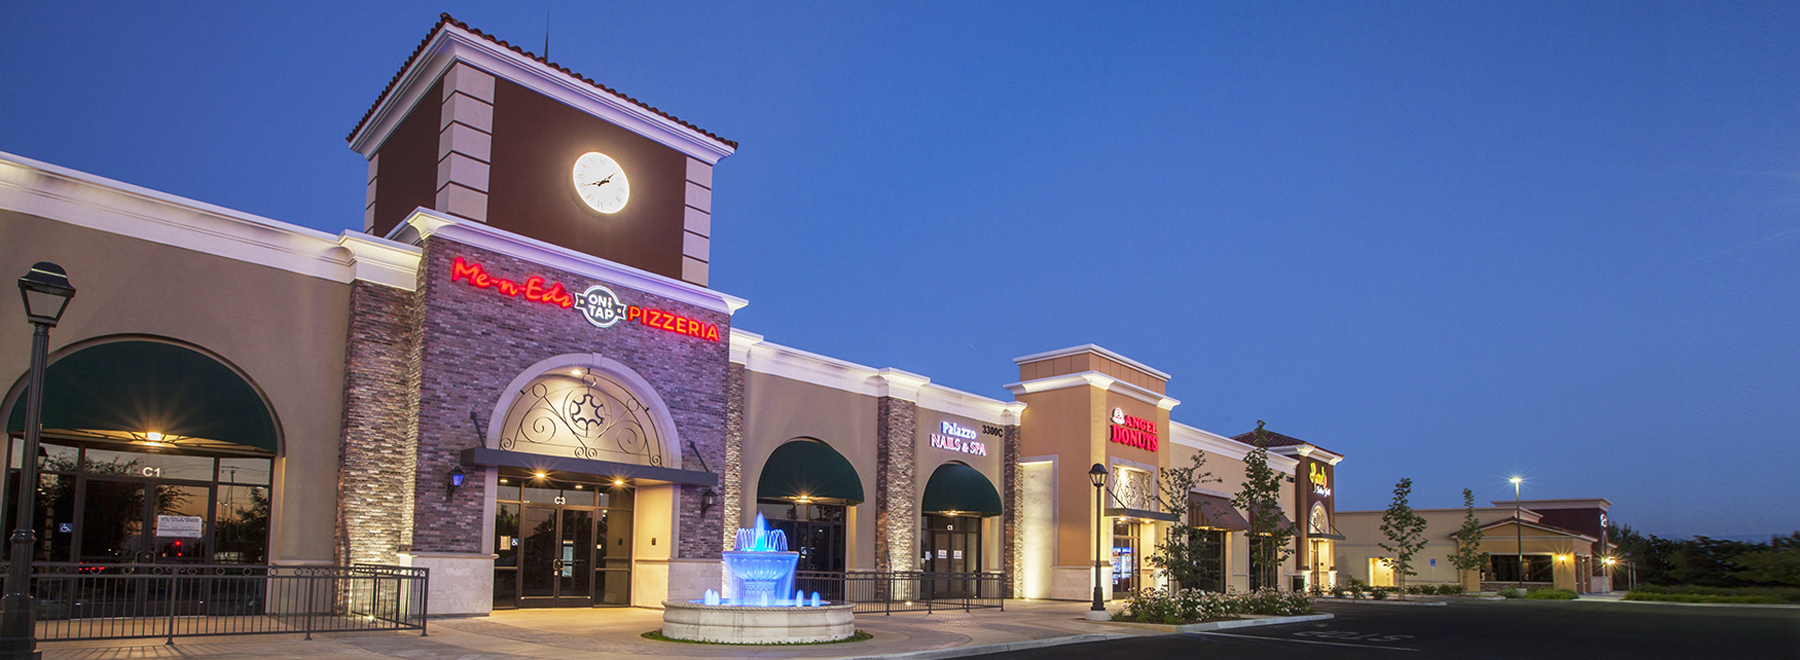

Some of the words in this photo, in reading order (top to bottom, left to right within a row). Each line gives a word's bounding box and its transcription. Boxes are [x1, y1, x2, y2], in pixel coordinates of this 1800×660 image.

[588, 304, 615, 320] TAP
[627, 305, 720, 342] PIZZERIA
[941, 421, 977, 440] Palazzo
[982, 425, 1003, 438] 3300C
[1124, 414, 1158, 435] ANGEL
[930, 434, 961, 452] NAILS
[961, 442, 969, 454] &
[969, 441, 987, 456] SPA
[1110, 424, 1159, 452] DONUTS
[142, 467, 161, 478] C1
[554, 496, 566, 505] C3
